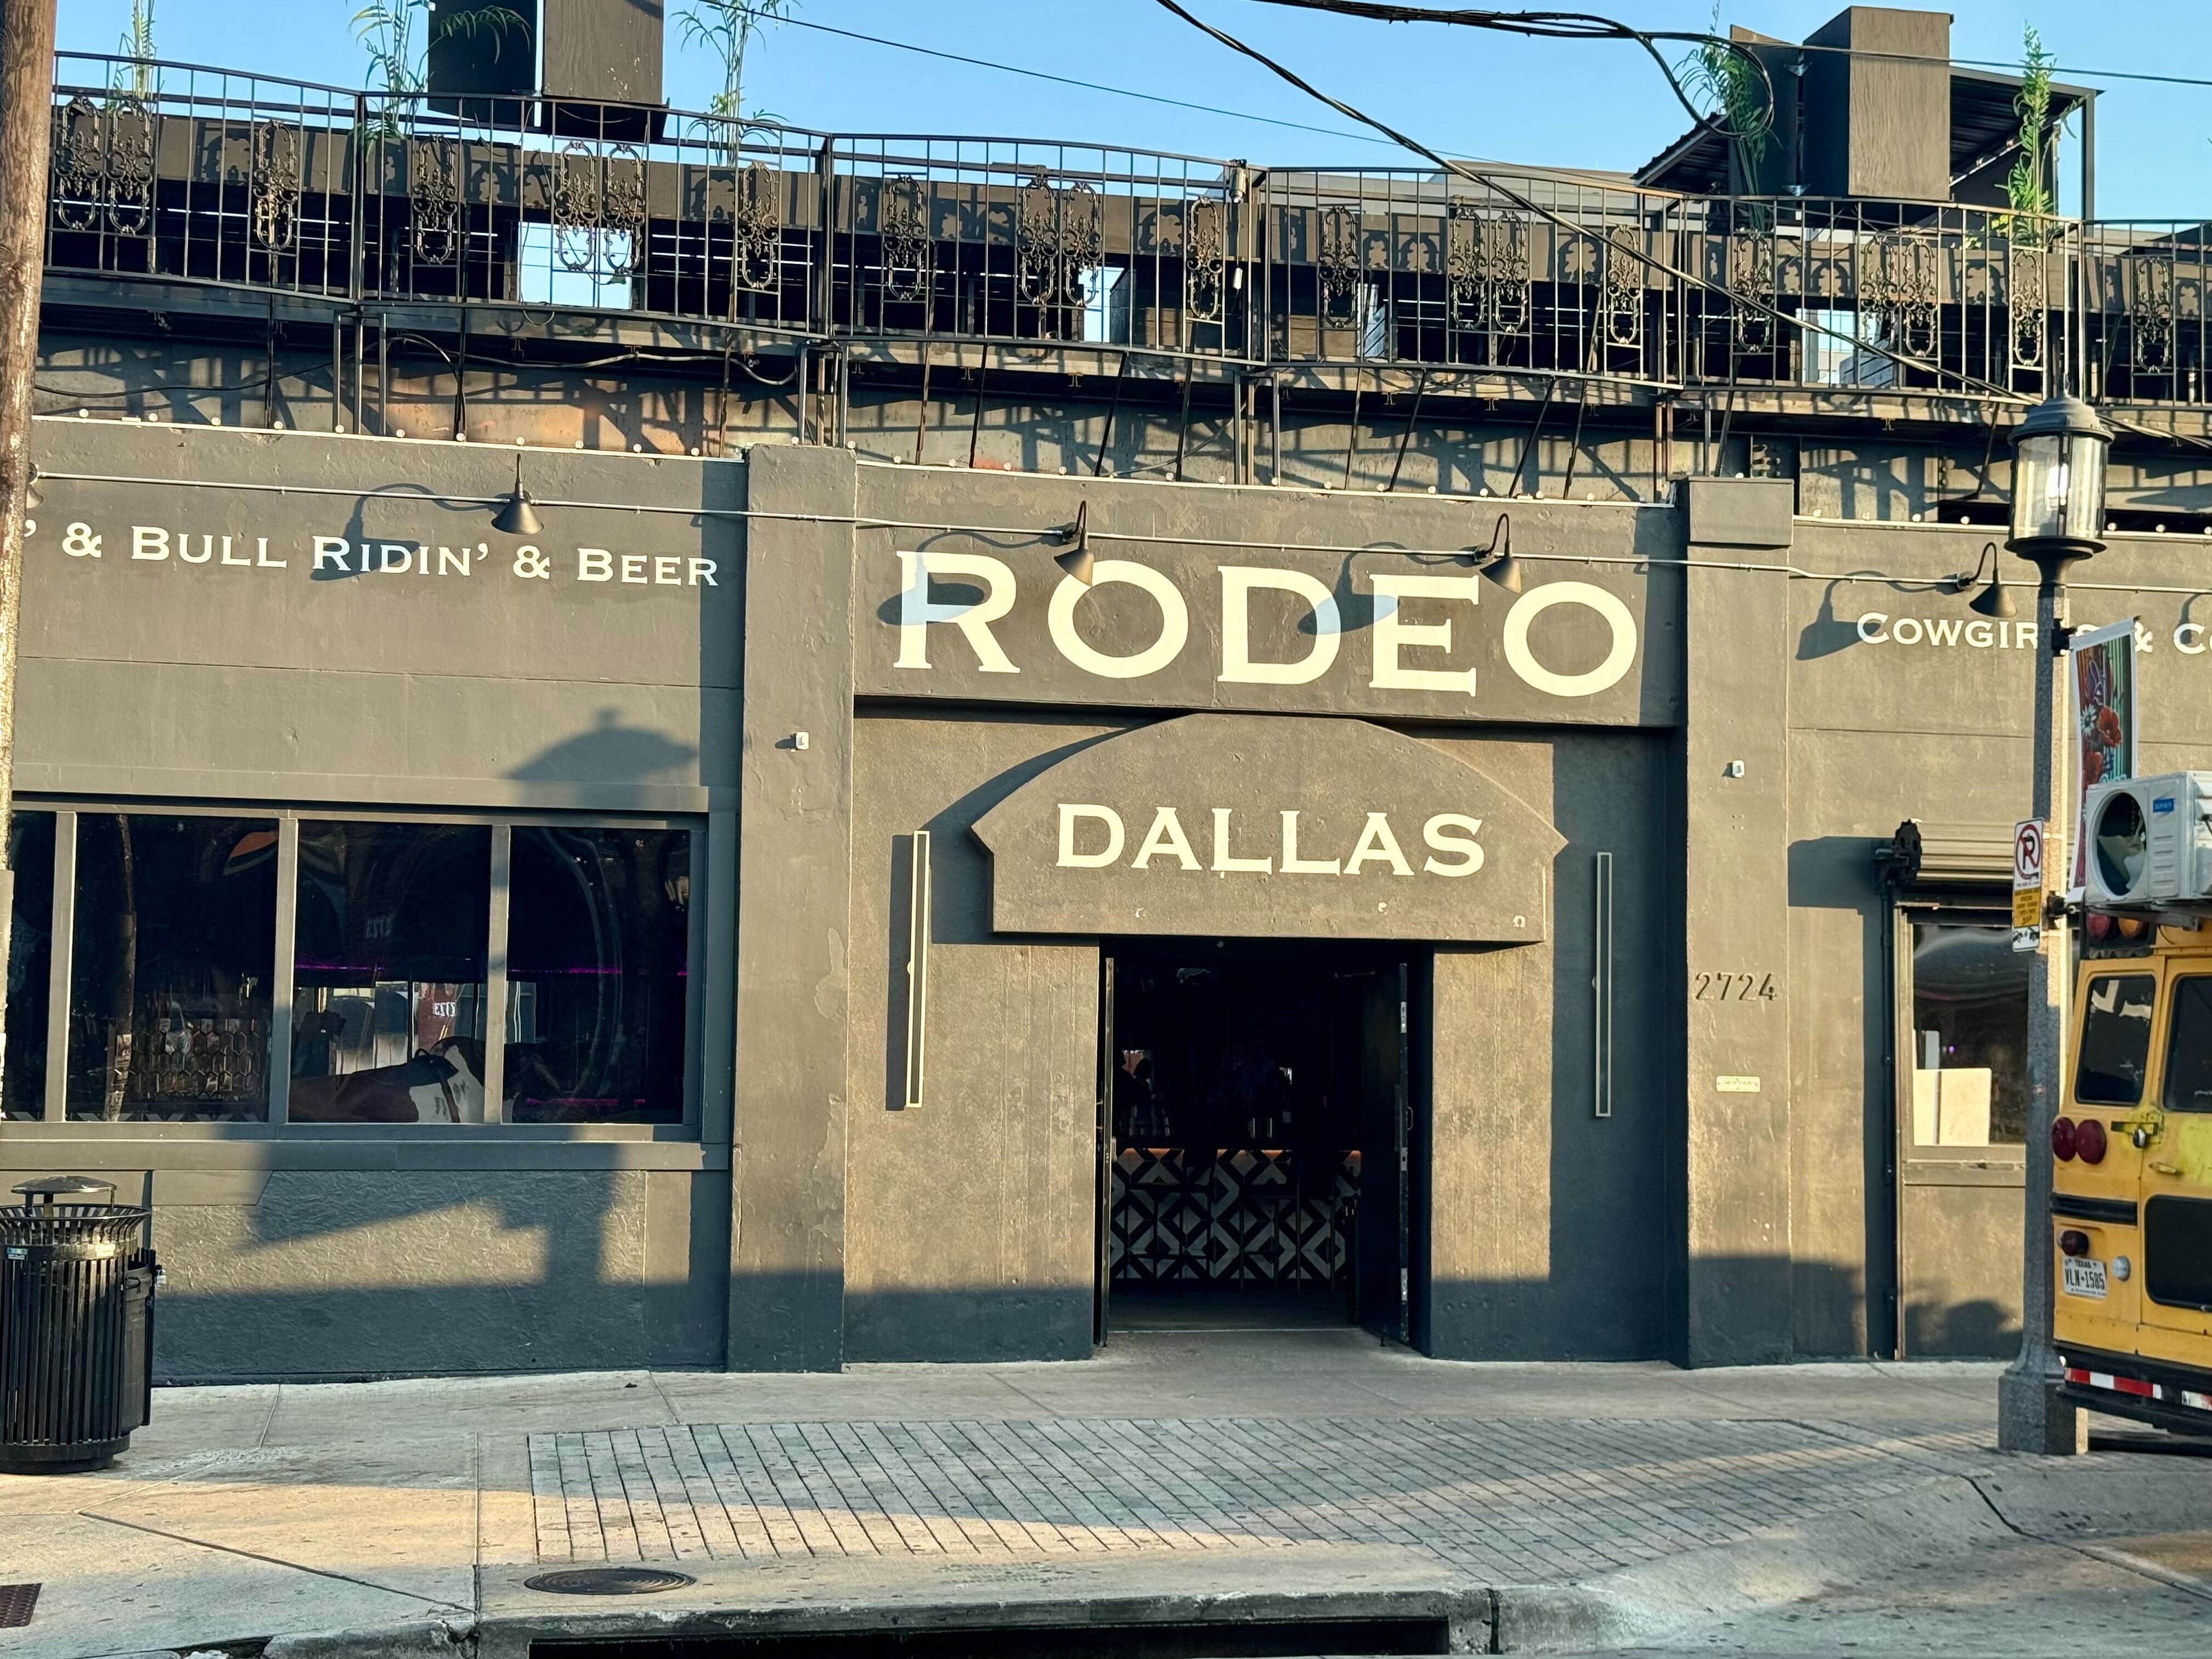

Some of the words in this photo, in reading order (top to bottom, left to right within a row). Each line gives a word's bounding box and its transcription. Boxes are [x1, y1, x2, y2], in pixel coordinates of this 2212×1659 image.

[62, 522, 102, 558] &
[131, 526, 287, 568] BULL
[513, 545, 550, 579] &
[577, 548, 719, 586] BEER
[893, 550, 1638, 697] RODEO
[1857, 612, 2100, 649] COWGIR
[2173, 623, 2212, 654] C
[1056, 803, 1485, 877] DALLAS
[1695, 973, 1778, 1001] 2724
